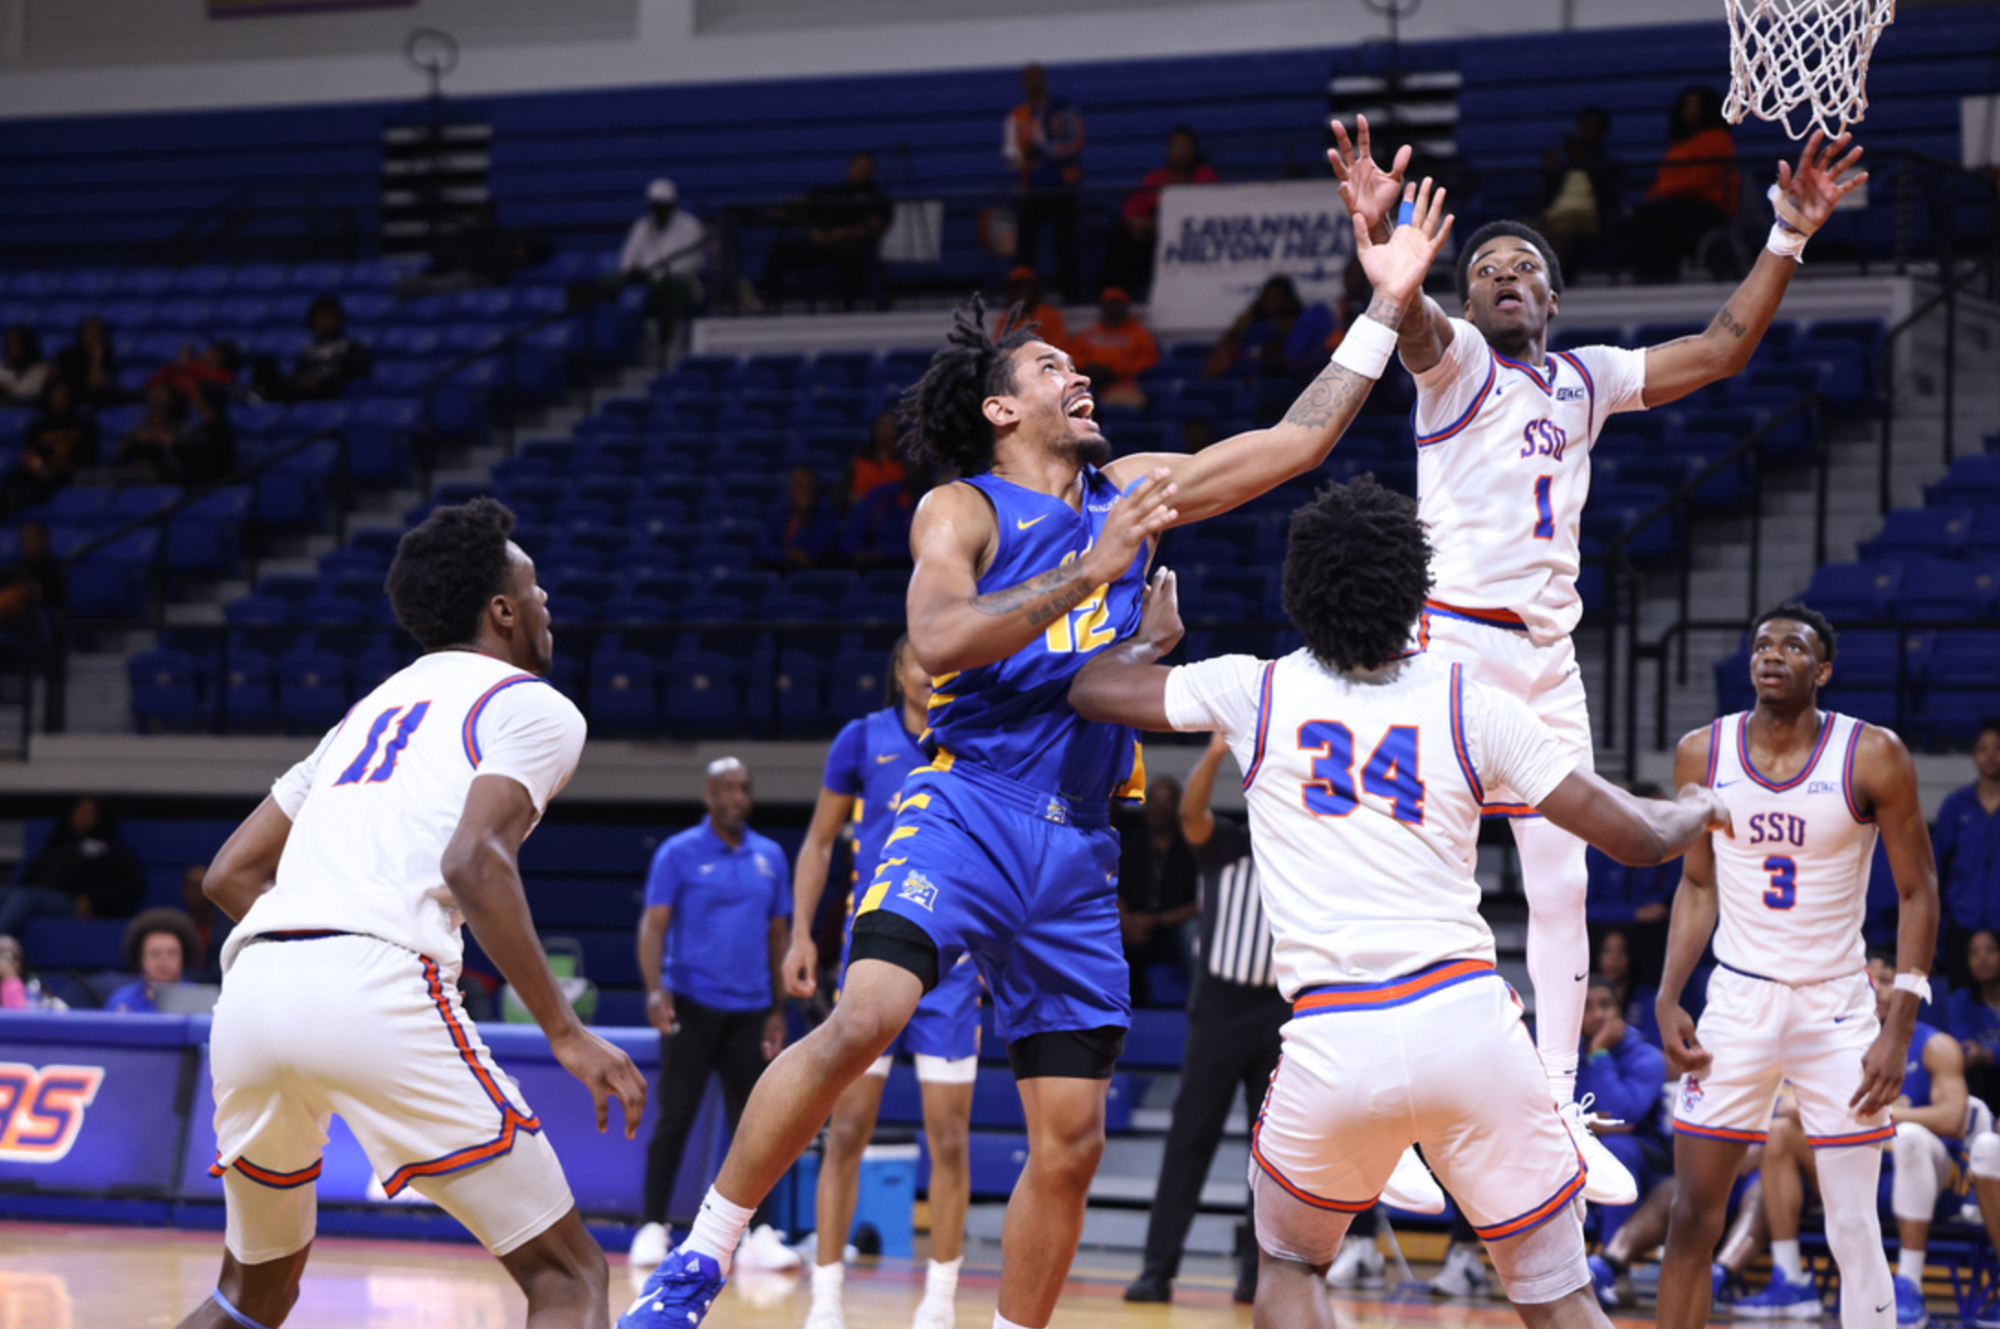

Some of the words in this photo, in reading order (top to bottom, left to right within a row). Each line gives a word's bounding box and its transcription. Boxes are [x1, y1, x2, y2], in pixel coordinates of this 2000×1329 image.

[1283, 230, 1357, 260] HEA
[1520, 417, 1567, 462] SSU
[1533, 474, 1555, 540] 1
[1045, 582, 1116, 653] 12
[331, 699, 432, 788] 11
[1296, 719, 1426, 827] 34
[1749, 812, 1806, 847] SSU
[1762, 854, 1797, 912] 3
